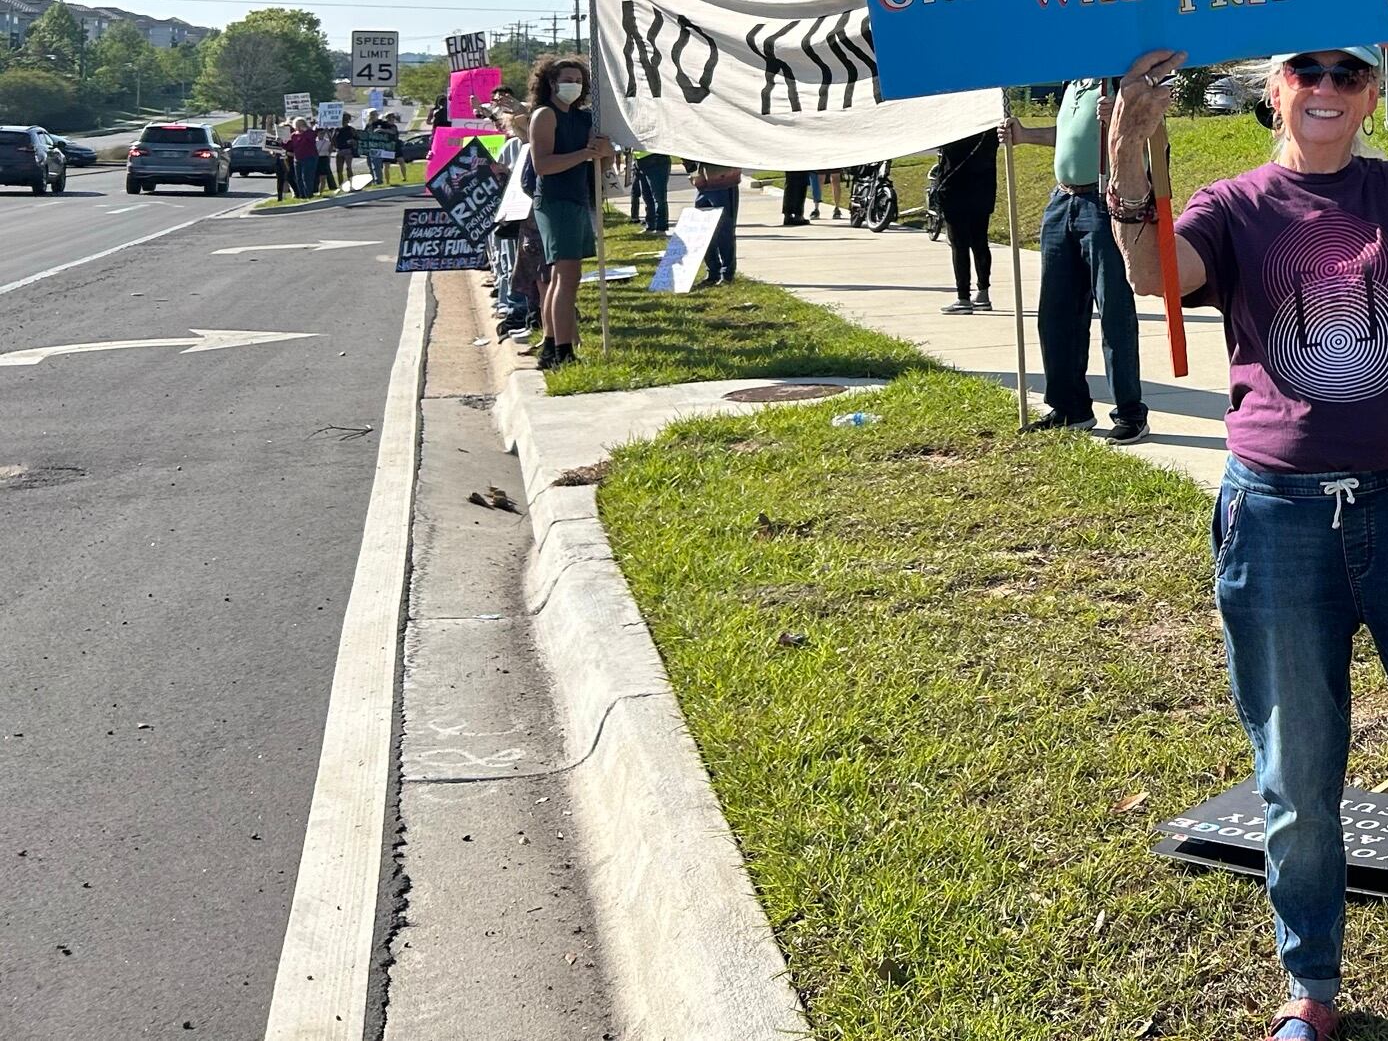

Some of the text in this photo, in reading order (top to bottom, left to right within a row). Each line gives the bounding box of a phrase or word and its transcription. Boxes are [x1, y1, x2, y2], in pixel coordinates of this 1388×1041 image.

[356, 37, 395, 45] SPEED
[446, 33, 474, 57] ELON
[360, 50, 391, 58] LIMIT
[621, 0, 883, 115] NO KIN
[356, 63, 393, 81] 45
[430, 146, 488, 198] TAX
[462, 179, 480, 194] THE
[450, 176, 499, 226] RICH
[408, 211, 452, 225] SOLID
[408, 226, 443, 239] HANDS
[402, 239, 486, 257] LIVES FUTUE
[1167, 817, 1266, 842] DOGE
